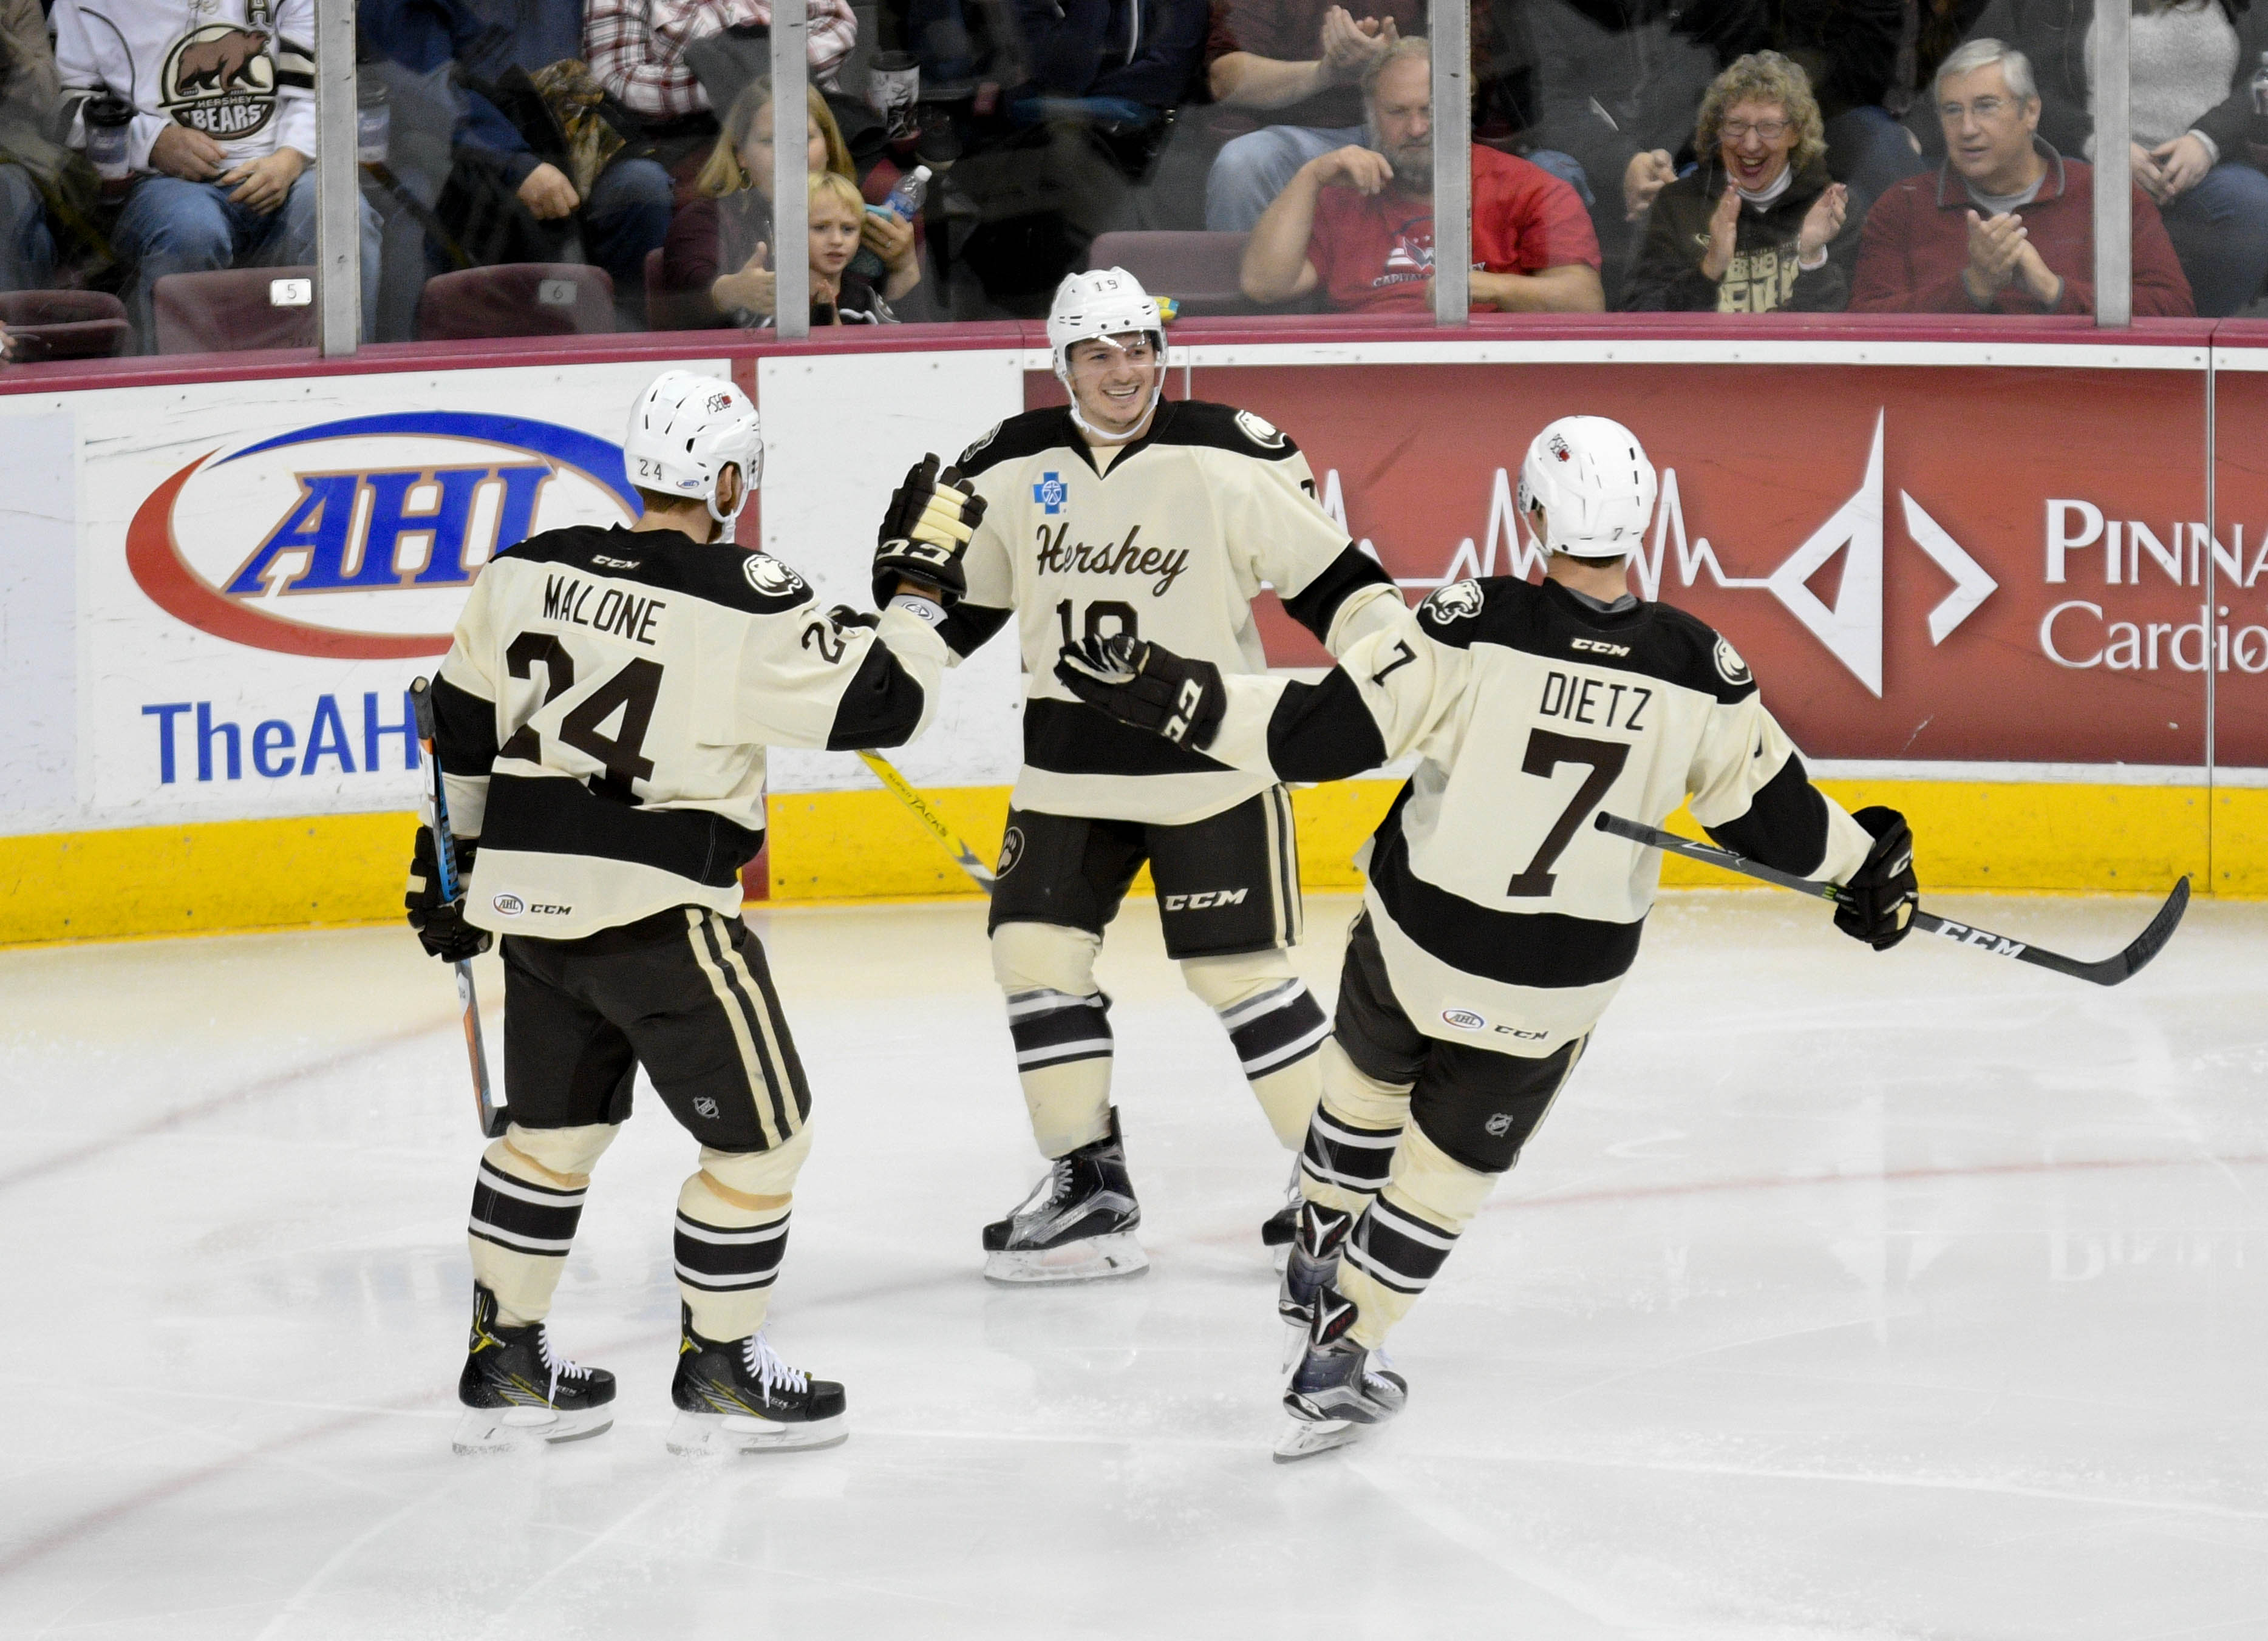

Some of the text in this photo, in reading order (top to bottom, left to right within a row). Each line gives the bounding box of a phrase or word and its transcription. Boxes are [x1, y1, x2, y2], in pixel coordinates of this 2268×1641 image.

[197, 95, 253, 108] HERSHEY
[190, 104, 262, 132] BEARS
[287, 283, 298, 300] 5
[553, 285, 564, 299] 6
[1095, 279, 1119, 292] 19
[639, 458, 662, 481] 24
[1612, 527, 1624, 542] 7
[591, 554, 641, 569] CCM
[1036, 522, 1190, 597] Hershey
[543, 574, 667, 646] MALONE
[1570, 637, 1631, 657] CCM
[2039, 600, 2268, 674] Cardio
[1371, 638, 1418, 688] 7
[1539, 671, 1653, 732] DIETZ
[498, 631, 666, 806] 24
[1506, 727, 1632, 898] 7
[530, 903, 573, 916] CCM
[1165, 888, 1249, 911] CCM
[1934, 919, 2027, 959] CCM
[1449, 1013, 1477, 1026] AHL
[1494, 1024, 1549, 1040] CCM
